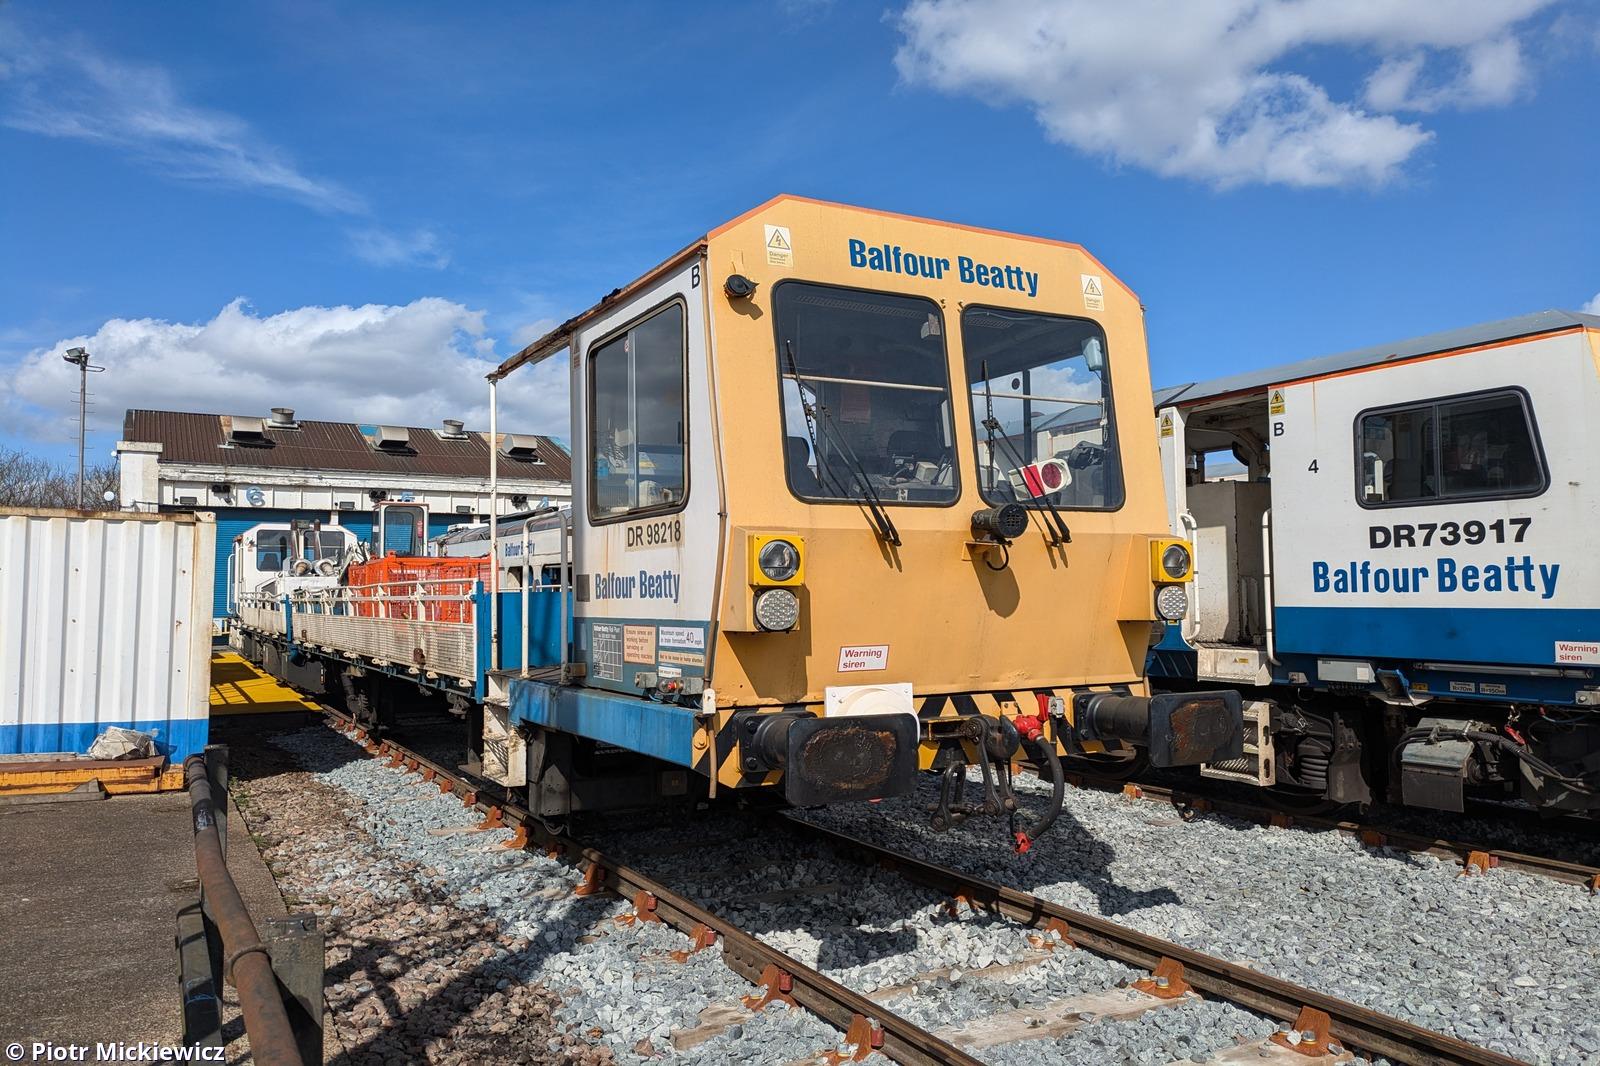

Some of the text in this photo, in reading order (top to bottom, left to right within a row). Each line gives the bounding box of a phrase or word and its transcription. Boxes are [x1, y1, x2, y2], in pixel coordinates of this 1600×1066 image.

[691, 264, 700, 290] B
[849, 238, 1039, 298] Balfour Beatty
[1273, 421, 1284, 437] B
[1307, 459, 1320, 474] 4
[246, 486, 264, 506] 6
[627, 519, 682, 548] DR 98218
[1368, 516, 1532, 549] DR73917
[1312, 555, 1560, 599] Balfour Beatty
[595, 570, 681, 604] Balfour Beatty
[686, 631, 695, 643] 40
[844, 648, 883, 659] Warning
[1559, 643, 1598, 654] Warning
[1559, 653, 1583, 661] siren
[842, 660, 866, 669] siren
